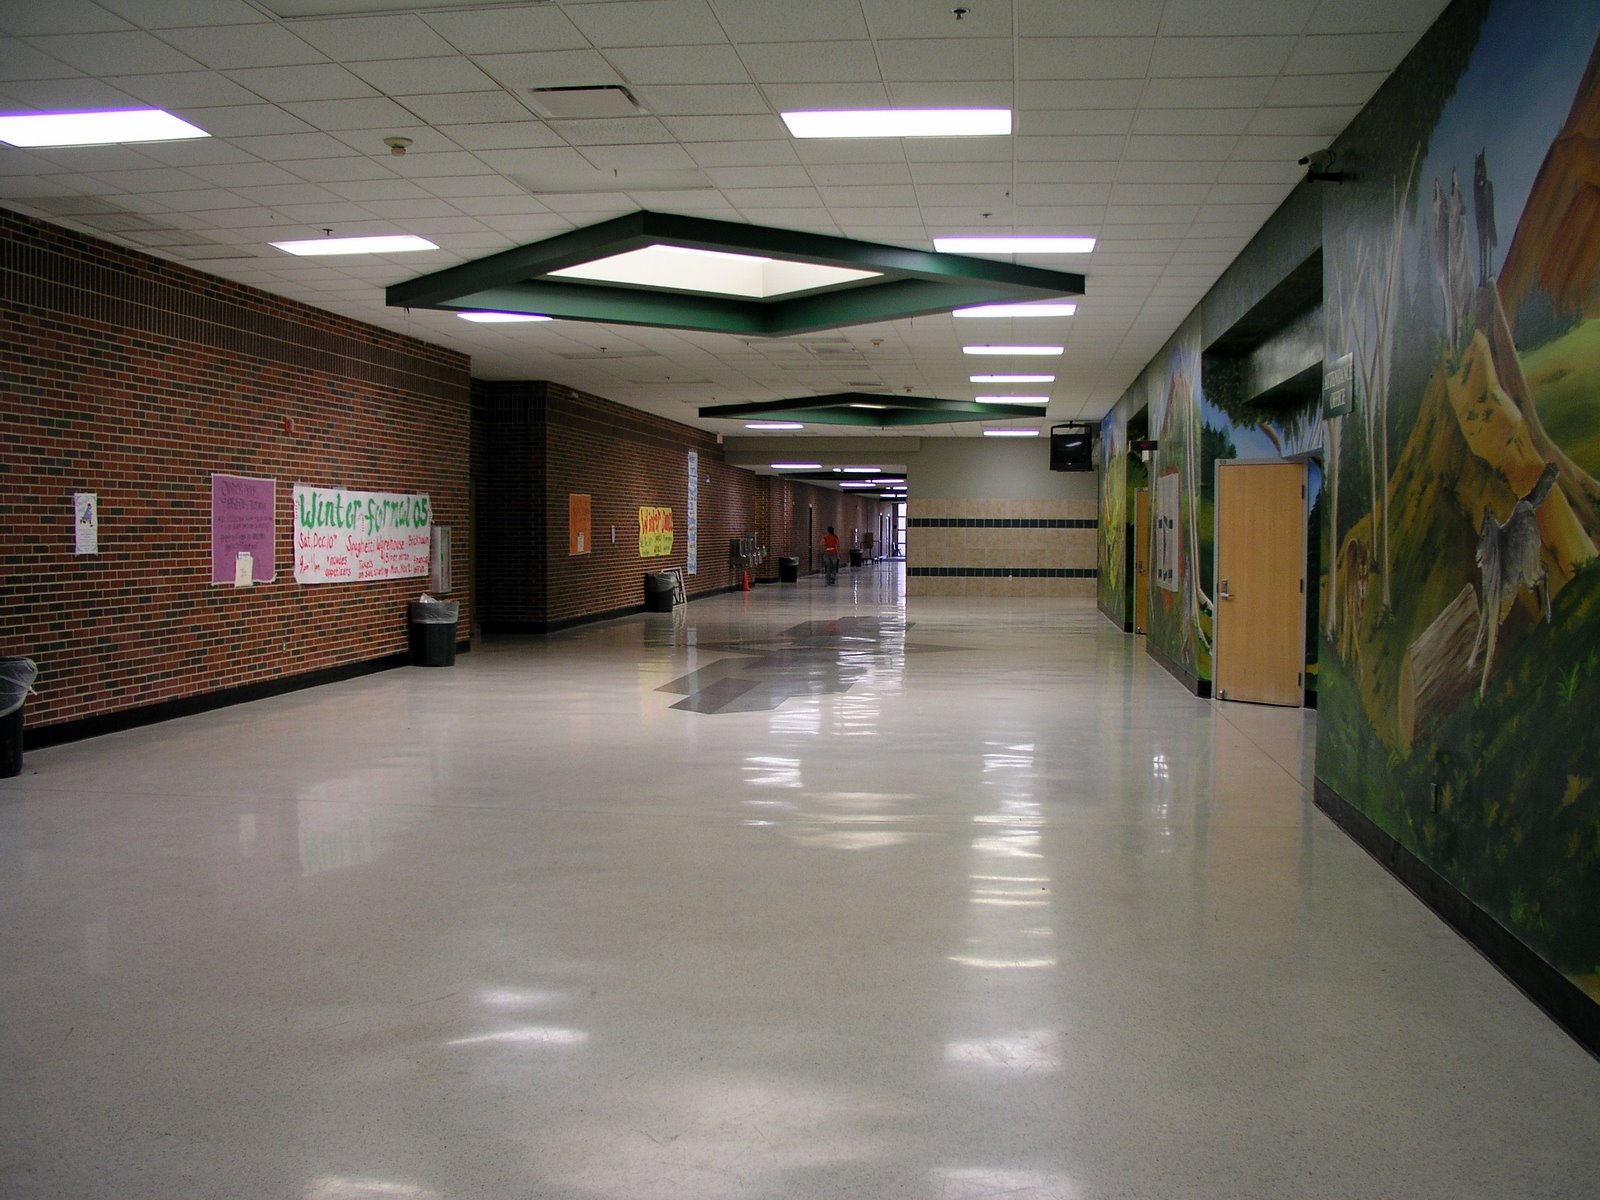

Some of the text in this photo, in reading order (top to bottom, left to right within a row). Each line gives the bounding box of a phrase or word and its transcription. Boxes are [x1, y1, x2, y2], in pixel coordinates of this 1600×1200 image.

[1330, 388, 1345, 409] OFFICE
[299, 491, 361, 530] Winter
[365, 496, 410, 536] formal
[346, 534, 375, 558] Spaghetti
[376, 535, 404, 551] Warehouse
